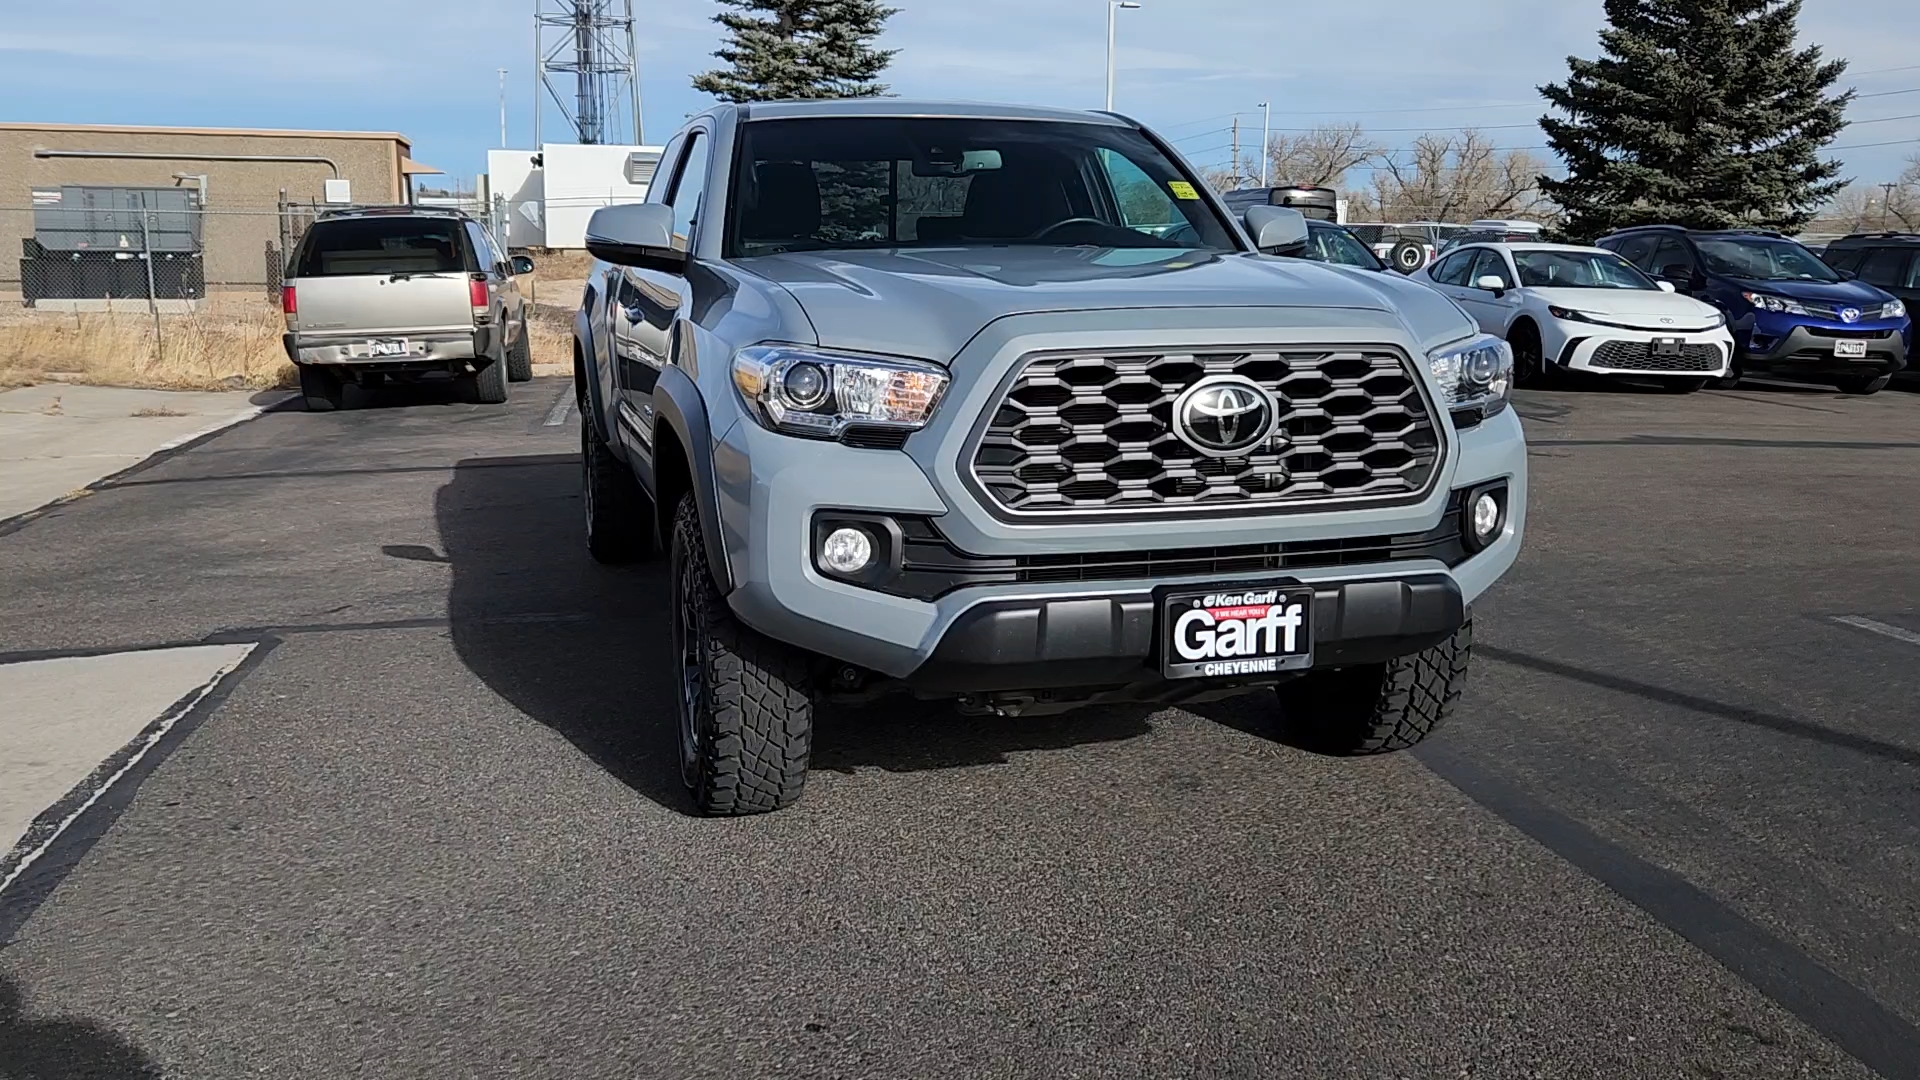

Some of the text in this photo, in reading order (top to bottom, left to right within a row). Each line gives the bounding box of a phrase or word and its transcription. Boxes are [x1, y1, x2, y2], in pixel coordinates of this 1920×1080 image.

[1215, 590, 1278, 607] Ken Garff
[1174, 604, 1302, 660] Garff
[1204, 659, 1276, 676] CHEYENNE
